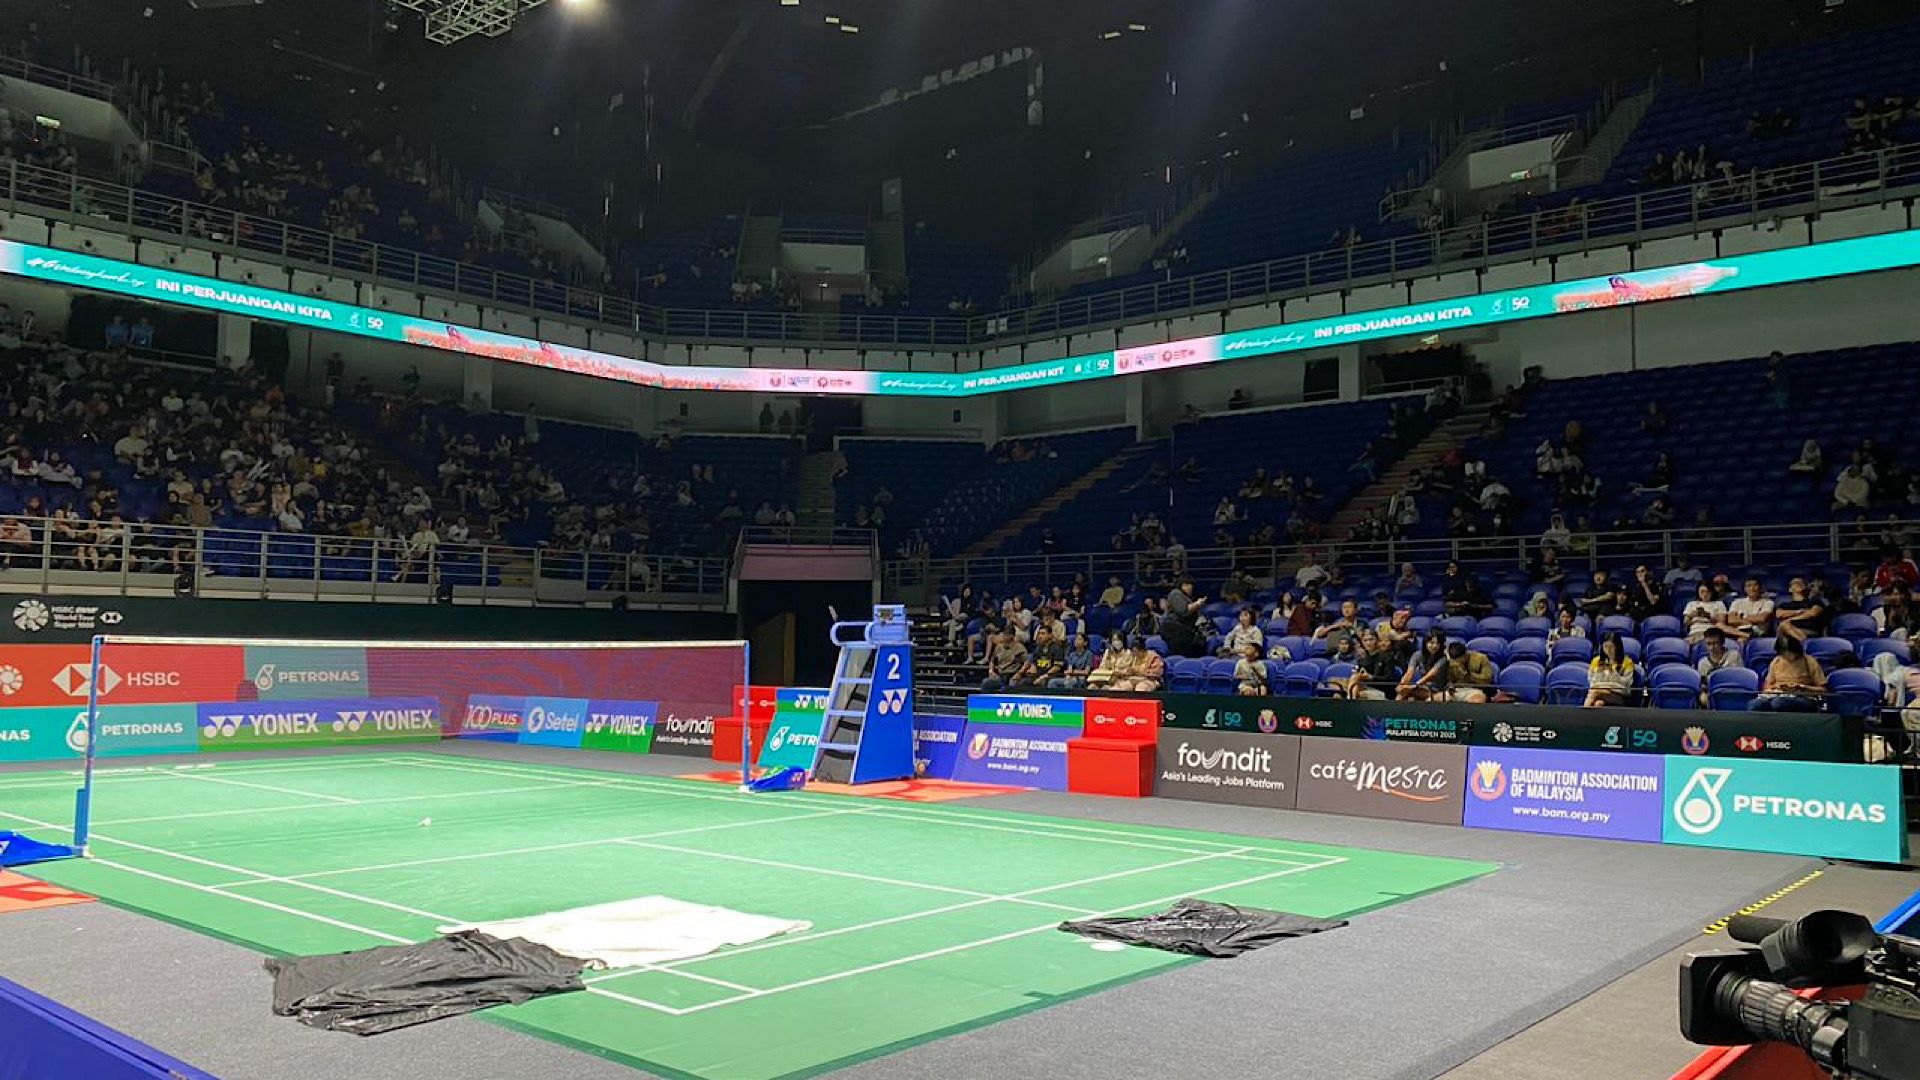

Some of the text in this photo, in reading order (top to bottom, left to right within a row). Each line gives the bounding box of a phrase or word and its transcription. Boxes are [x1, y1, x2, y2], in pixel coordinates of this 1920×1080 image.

[155, 278, 333, 321] INI PERJUANGAN KITA
[1511, 297, 1530, 310] 50
[367, 316, 385, 329] 50
[1314, 306, 1473, 339] INI PERJUANGAN KITA
[886, 653, 900, 680] 2
[127, 671, 181, 687] HSBC
[278, 670, 361, 683] PETRONAS
[371, 709, 433, 731] YONEX
[1018, 703, 1053, 719] YONEX
[1224, 711, 1242, 728] 50
[102, 722, 184, 736] PETRONAS
[249, 712, 320, 736] YONEX
[545, 711, 580, 733] Setel
[609, 714, 649, 736] YONEX
[666, 714, 715, 734] foundi
[1384, 717, 1457, 731] PETRONAS
[786, 733, 819, 746] PETR
[1385, 729, 1419, 738] MALAYSIA
[1439, 731, 1457, 739] 2025
[1632, 729, 1658, 747] 50
[1766, 740, 1791, 750] HSBC
[1177, 742, 1272, 773] foundit
[1161, 771, 1285, 790] Asia's Leading Jobs Platform
[1511, 768, 1658, 793] BADMINTON ASSOCIATION
[1510, 783, 1585, 802] OF MALAYSIA
[1512, 805, 1610, 823] www.bam.org.my
[1733, 794, 1886, 823] PETRONAS
